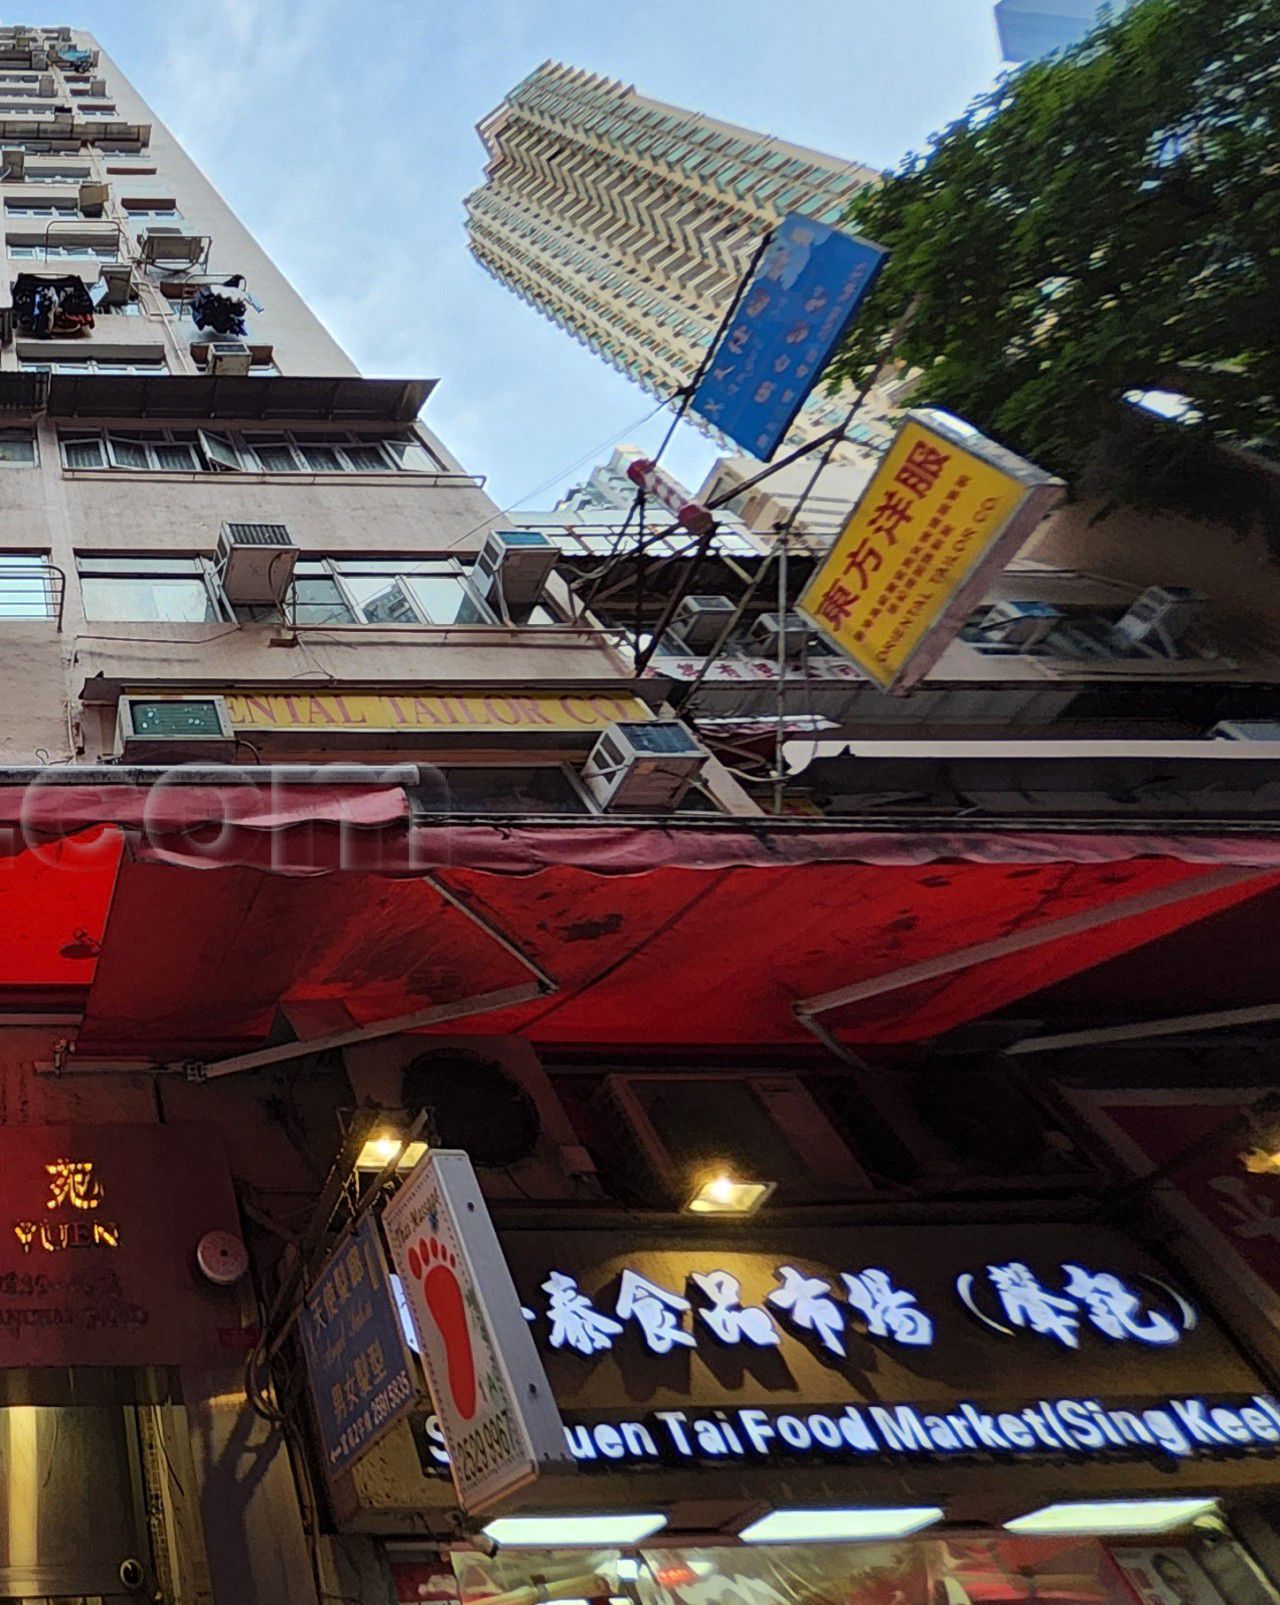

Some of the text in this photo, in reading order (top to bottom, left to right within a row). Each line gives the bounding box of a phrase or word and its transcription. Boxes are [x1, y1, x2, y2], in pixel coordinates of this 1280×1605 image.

[814, 439, 951, 632] 東方洋服
[226, 694, 368, 724] ENTAL
[380, 694, 556, 725] TAILOR
[14, 1220, 121, 1253] YUEN
[522, 1266, 934, 1358] 泰食品市場
[563, 1421, 659, 1461] uen
[653, 1409, 746, 1457] Tai
[736, 1405, 879, 1456] Food
